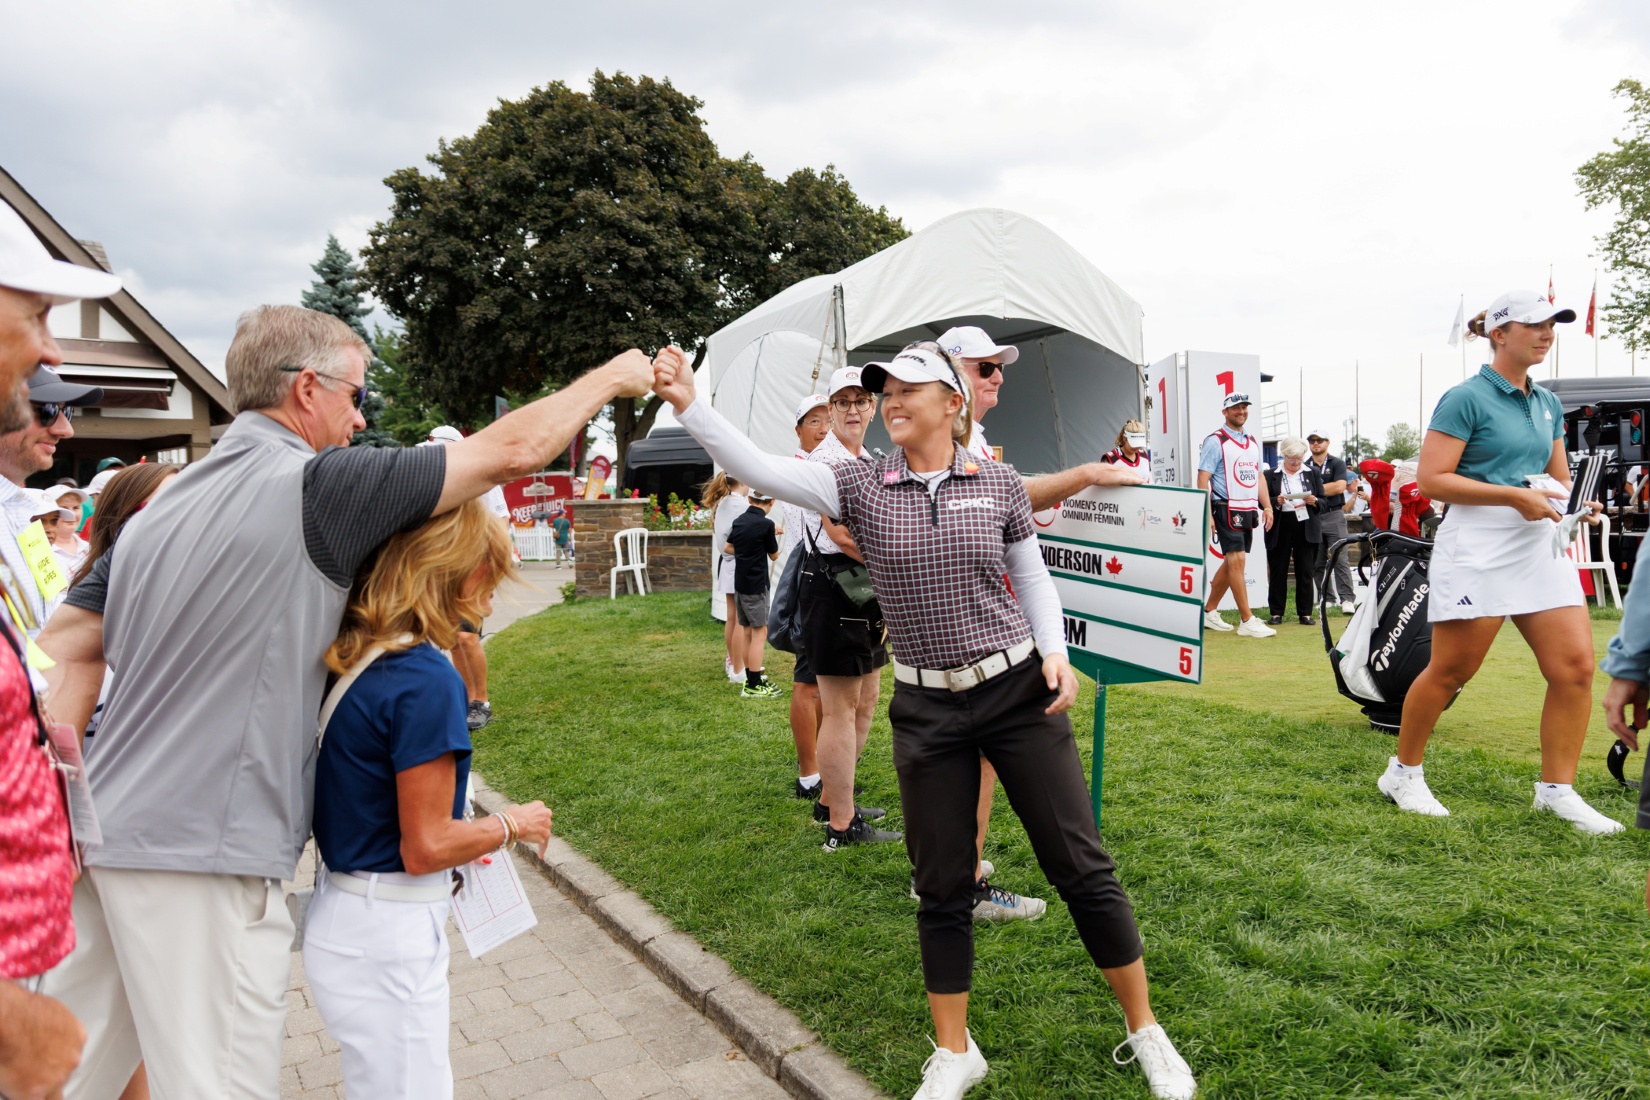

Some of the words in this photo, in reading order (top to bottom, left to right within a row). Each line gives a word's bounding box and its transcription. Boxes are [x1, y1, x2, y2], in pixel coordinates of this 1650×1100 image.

[1158, 376, 1168, 435] 1
[1165, 467, 1175, 482] 379
[948, 496, 996, 510] CPKC
[1062, 498, 1096, 511] WOMEN'S
[1098, 502, 1119, 513] OPEN
[1061, 509, 1093, 522] OMNIUM
[1093, 512, 1125, 526] FÉMININ
[1180, 566, 1194, 594] 5
[1370, 583, 1430, 671] TaylorMade
[1179, 647, 1193, 675] 5
